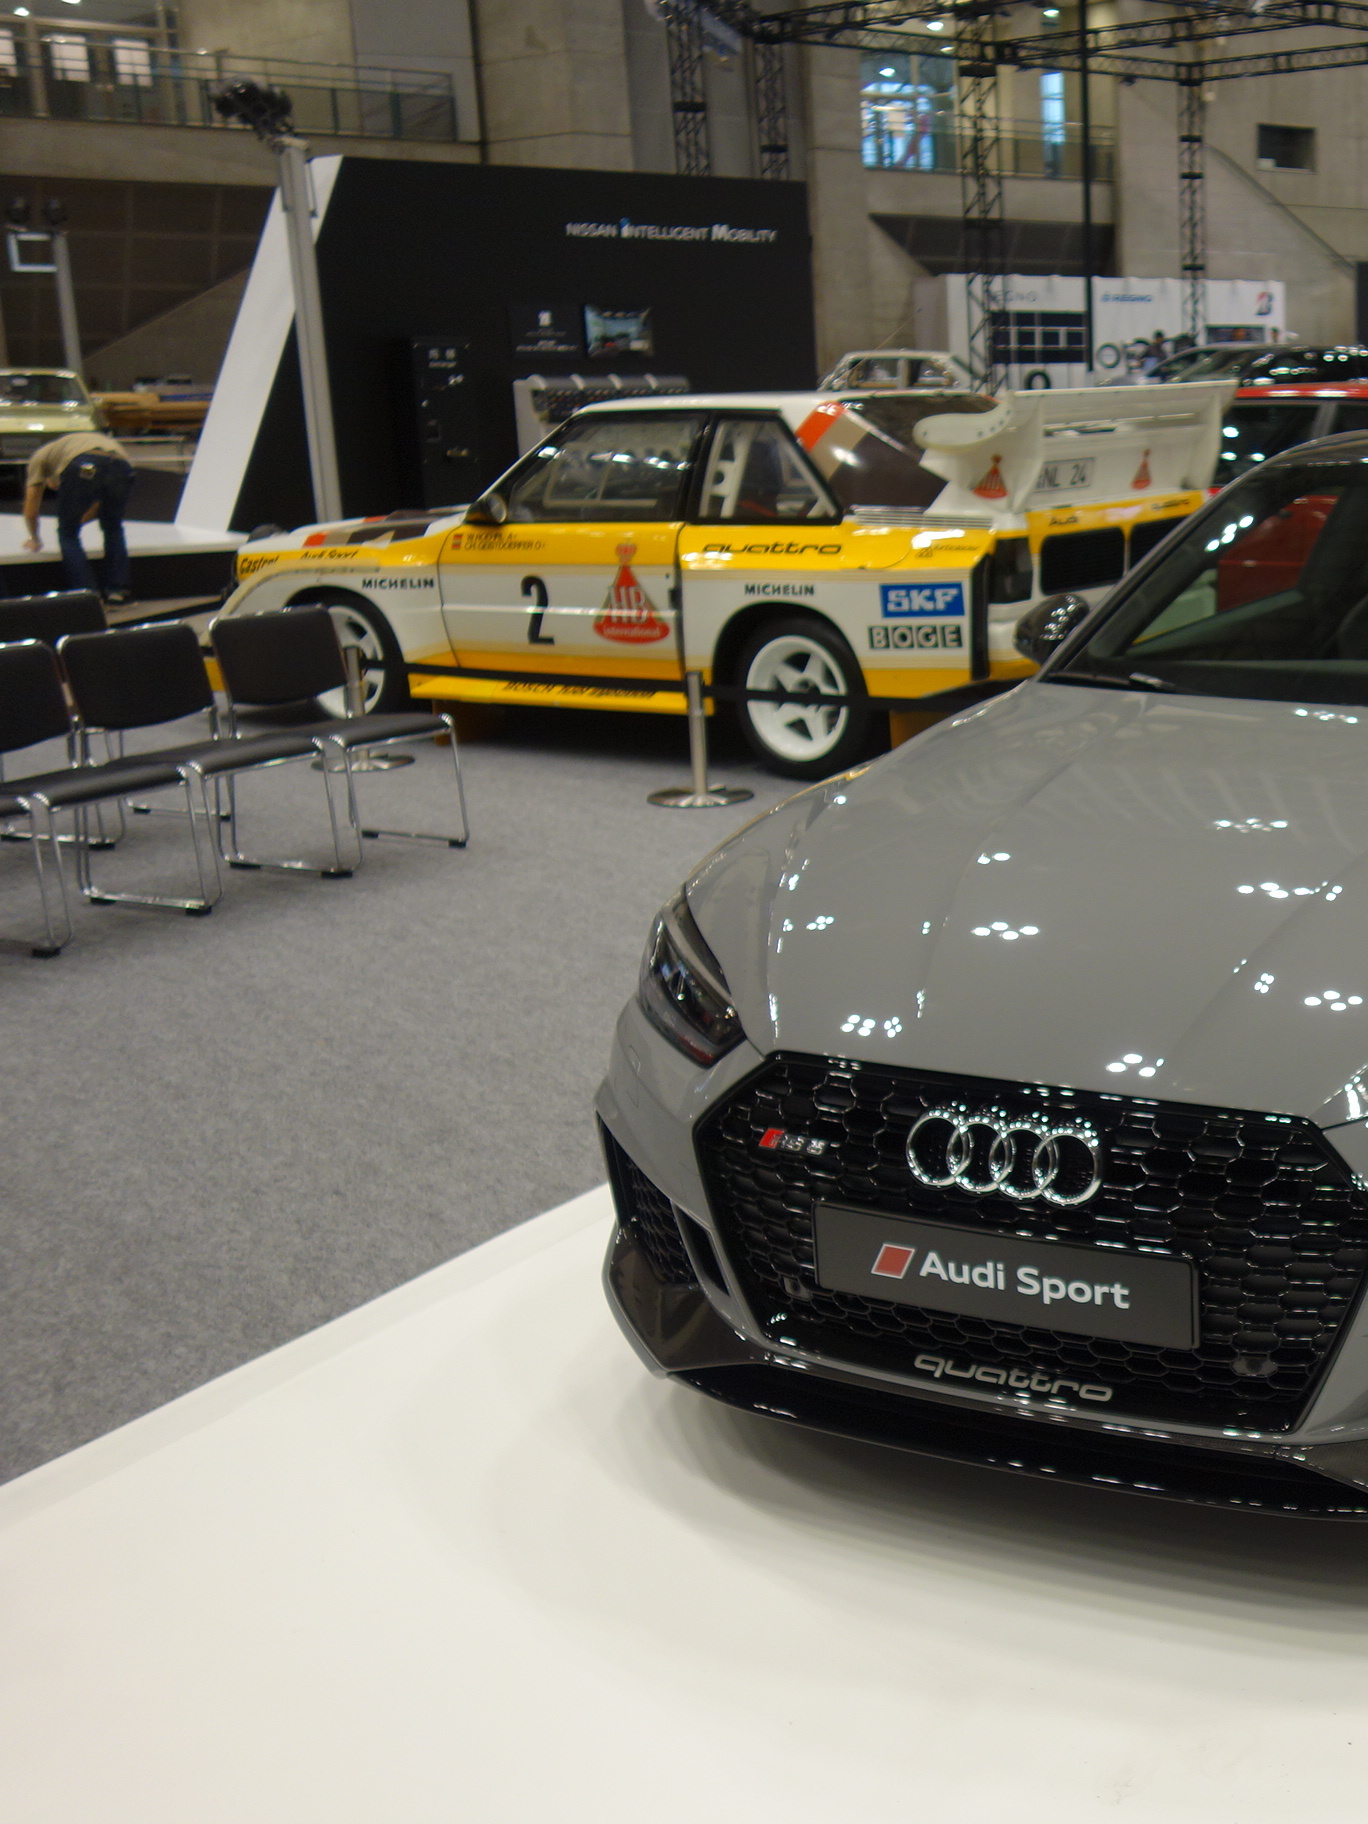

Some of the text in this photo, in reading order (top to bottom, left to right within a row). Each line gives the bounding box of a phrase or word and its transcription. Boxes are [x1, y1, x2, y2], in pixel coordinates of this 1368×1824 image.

[565, 222, 618, 238] NISSAN
[702, 542, 842, 555] quattro
[361, 578, 435, 590] MICHELIN
[744, 584, 815, 596] MICHELIN
[521, 575, 555, 645] 2
[887, 587, 959, 612] SKF
[870, 625, 961, 649] BOGE
[919, 1251, 1130, 1309] Audi Sport
[914, 1354, 1114, 1402] quattro
